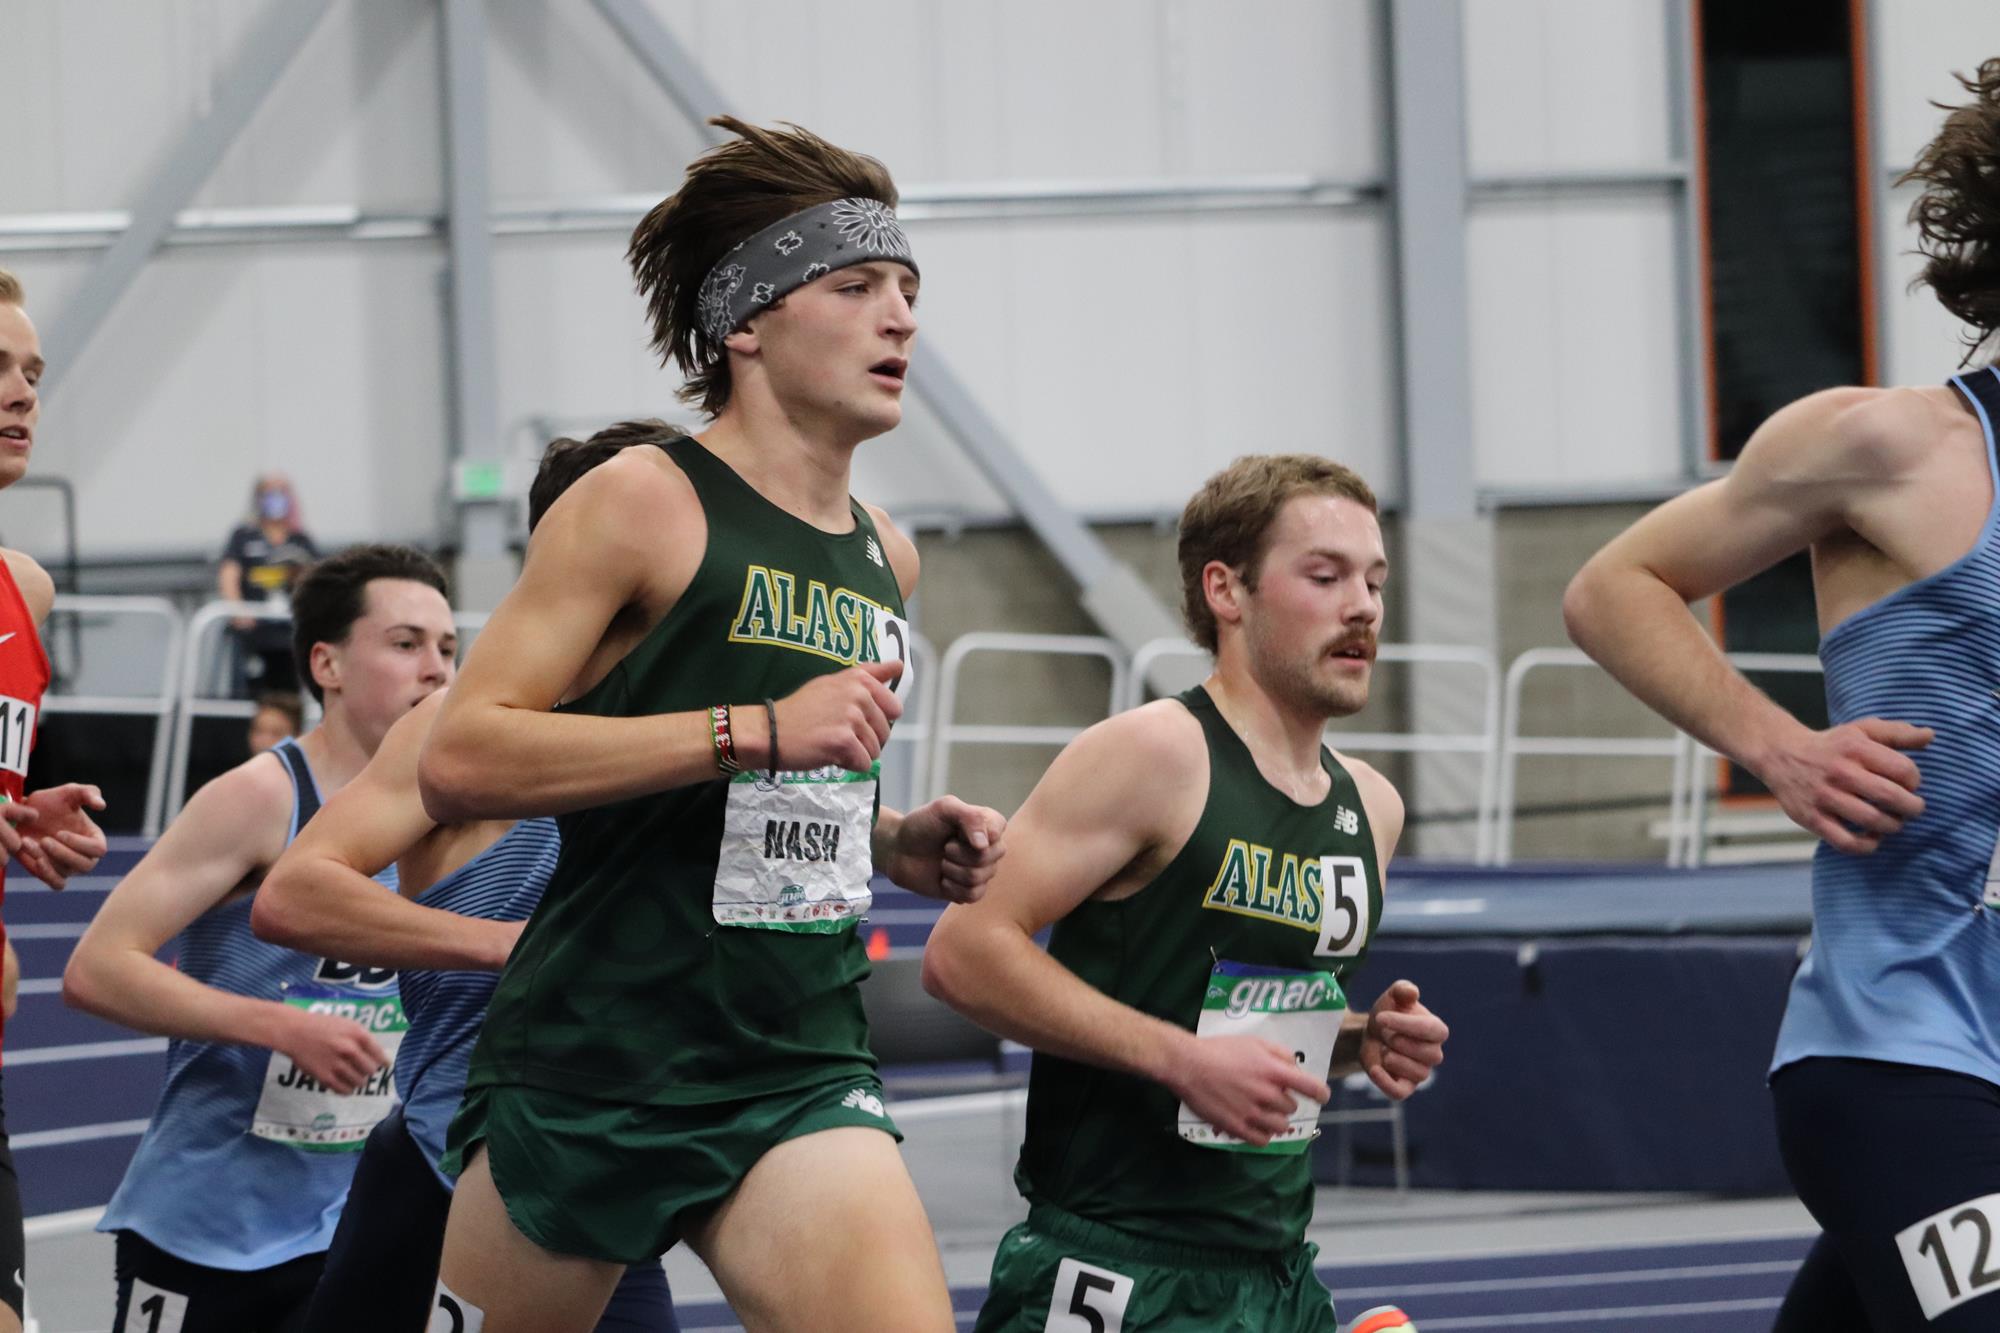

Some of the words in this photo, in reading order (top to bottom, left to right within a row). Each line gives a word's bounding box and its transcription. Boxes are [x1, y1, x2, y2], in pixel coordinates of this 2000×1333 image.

[728, 565, 893, 667] ALASK
[0, 702, 27, 769] 11
[763, 819, 841, 863] NASH
[1202, 839, 1325, 933] ALAS
[1327, 865, 1358, 952] 5
[1225, 979, 1325, 1019] gnac
[1919, 1208, 2000, 1300] 12
[1069, 1271, 1115, 1333] 5
